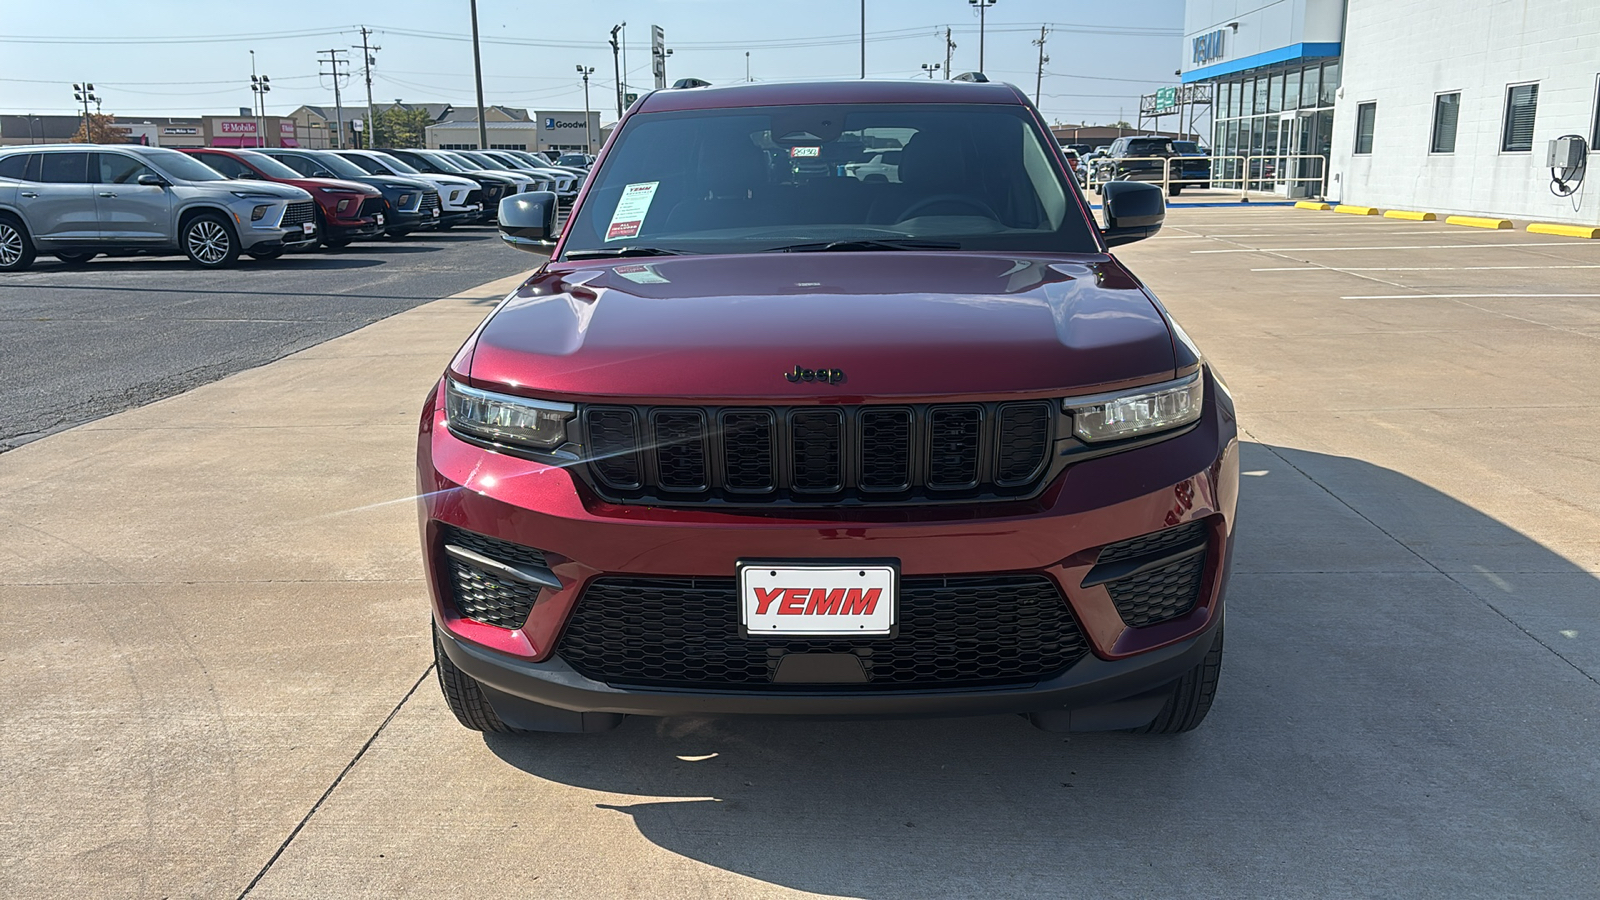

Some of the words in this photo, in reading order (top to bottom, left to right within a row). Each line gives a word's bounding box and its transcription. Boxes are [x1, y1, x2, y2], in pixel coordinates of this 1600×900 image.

[230, 123, 255, 132] Mobile
[555, 120, 587, 129] Goodwi
[784, 365, 843, 385] Jeep
[753, 587, 883, 616] YEMM
